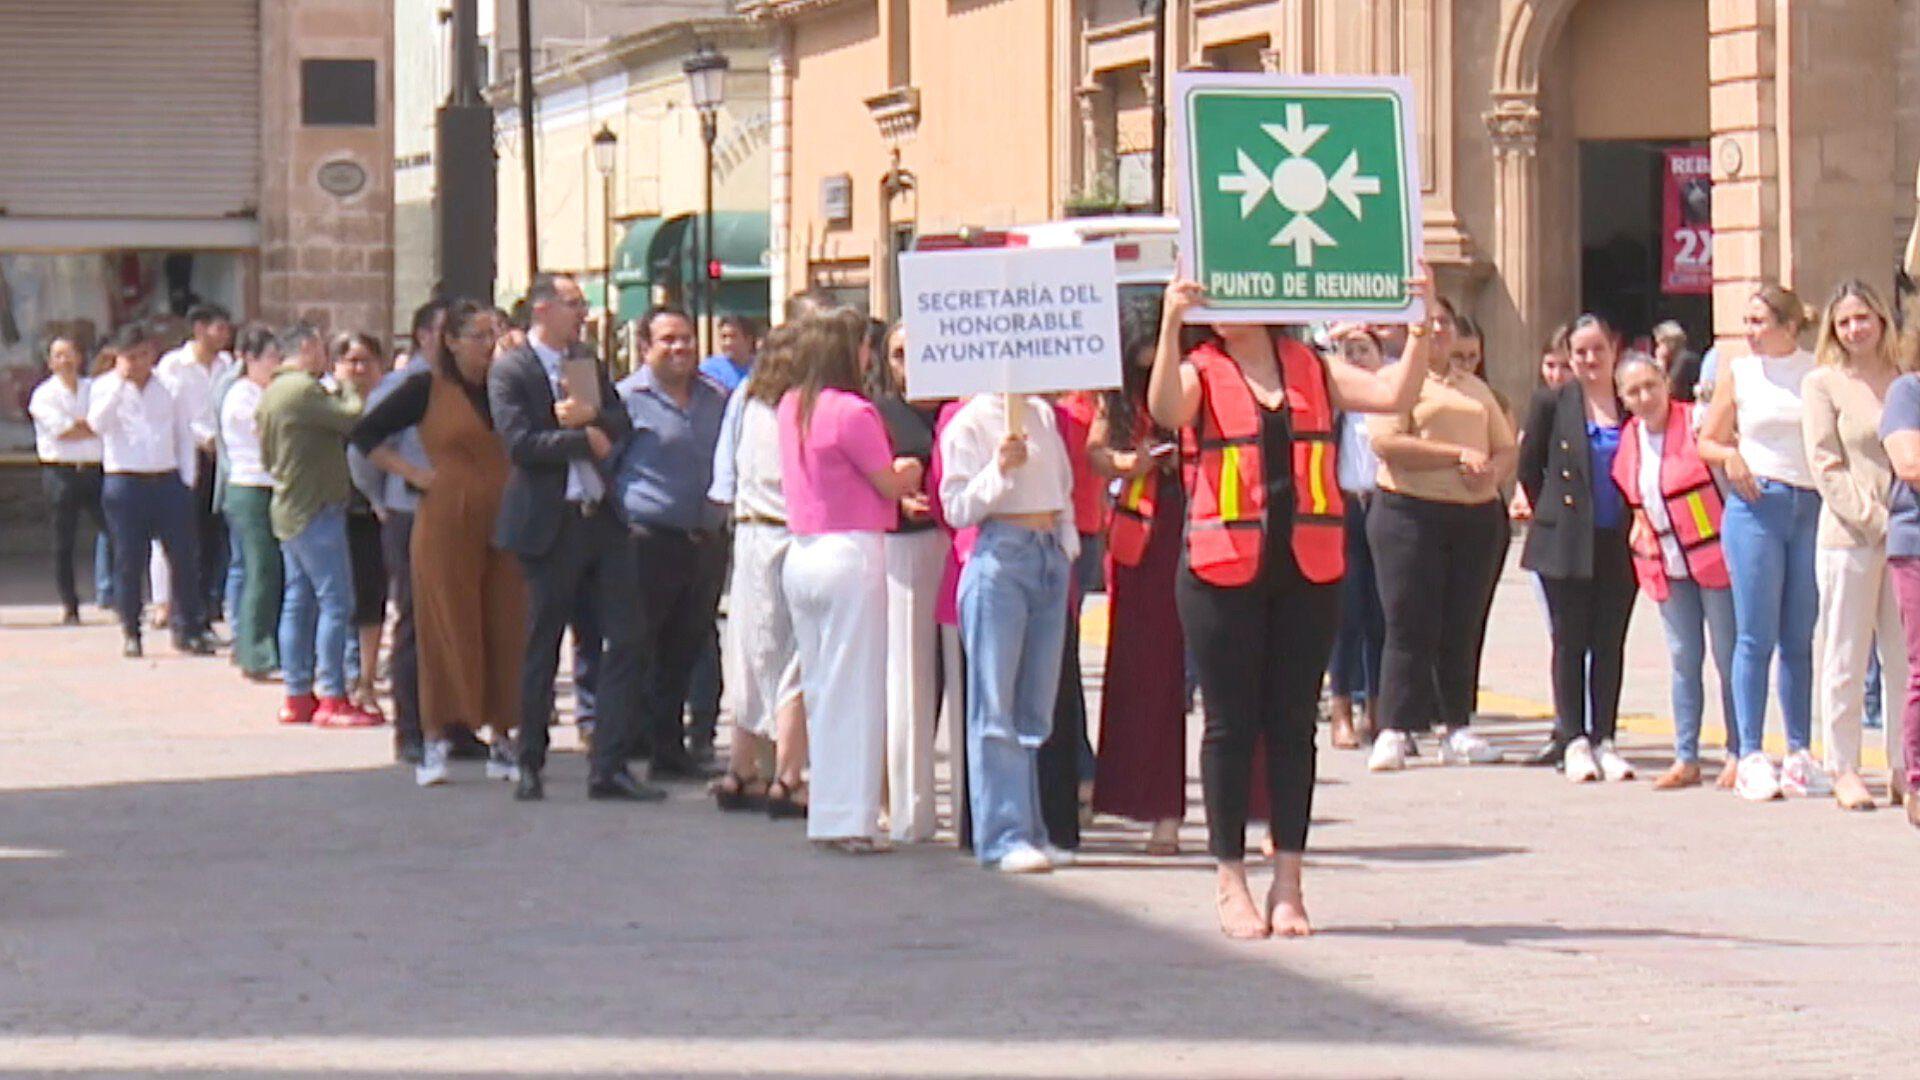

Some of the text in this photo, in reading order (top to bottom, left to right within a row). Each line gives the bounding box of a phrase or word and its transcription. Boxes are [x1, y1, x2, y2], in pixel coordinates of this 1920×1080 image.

[918, 282, 1103, 311] SECRETARÍA DEL
[1210, 271, 1398, 298] PUNTO DE REUNION
[940, 311, 1083, 336] HONORABLE
[921, 334, 1105, 363] AYUNTAMIENTO
